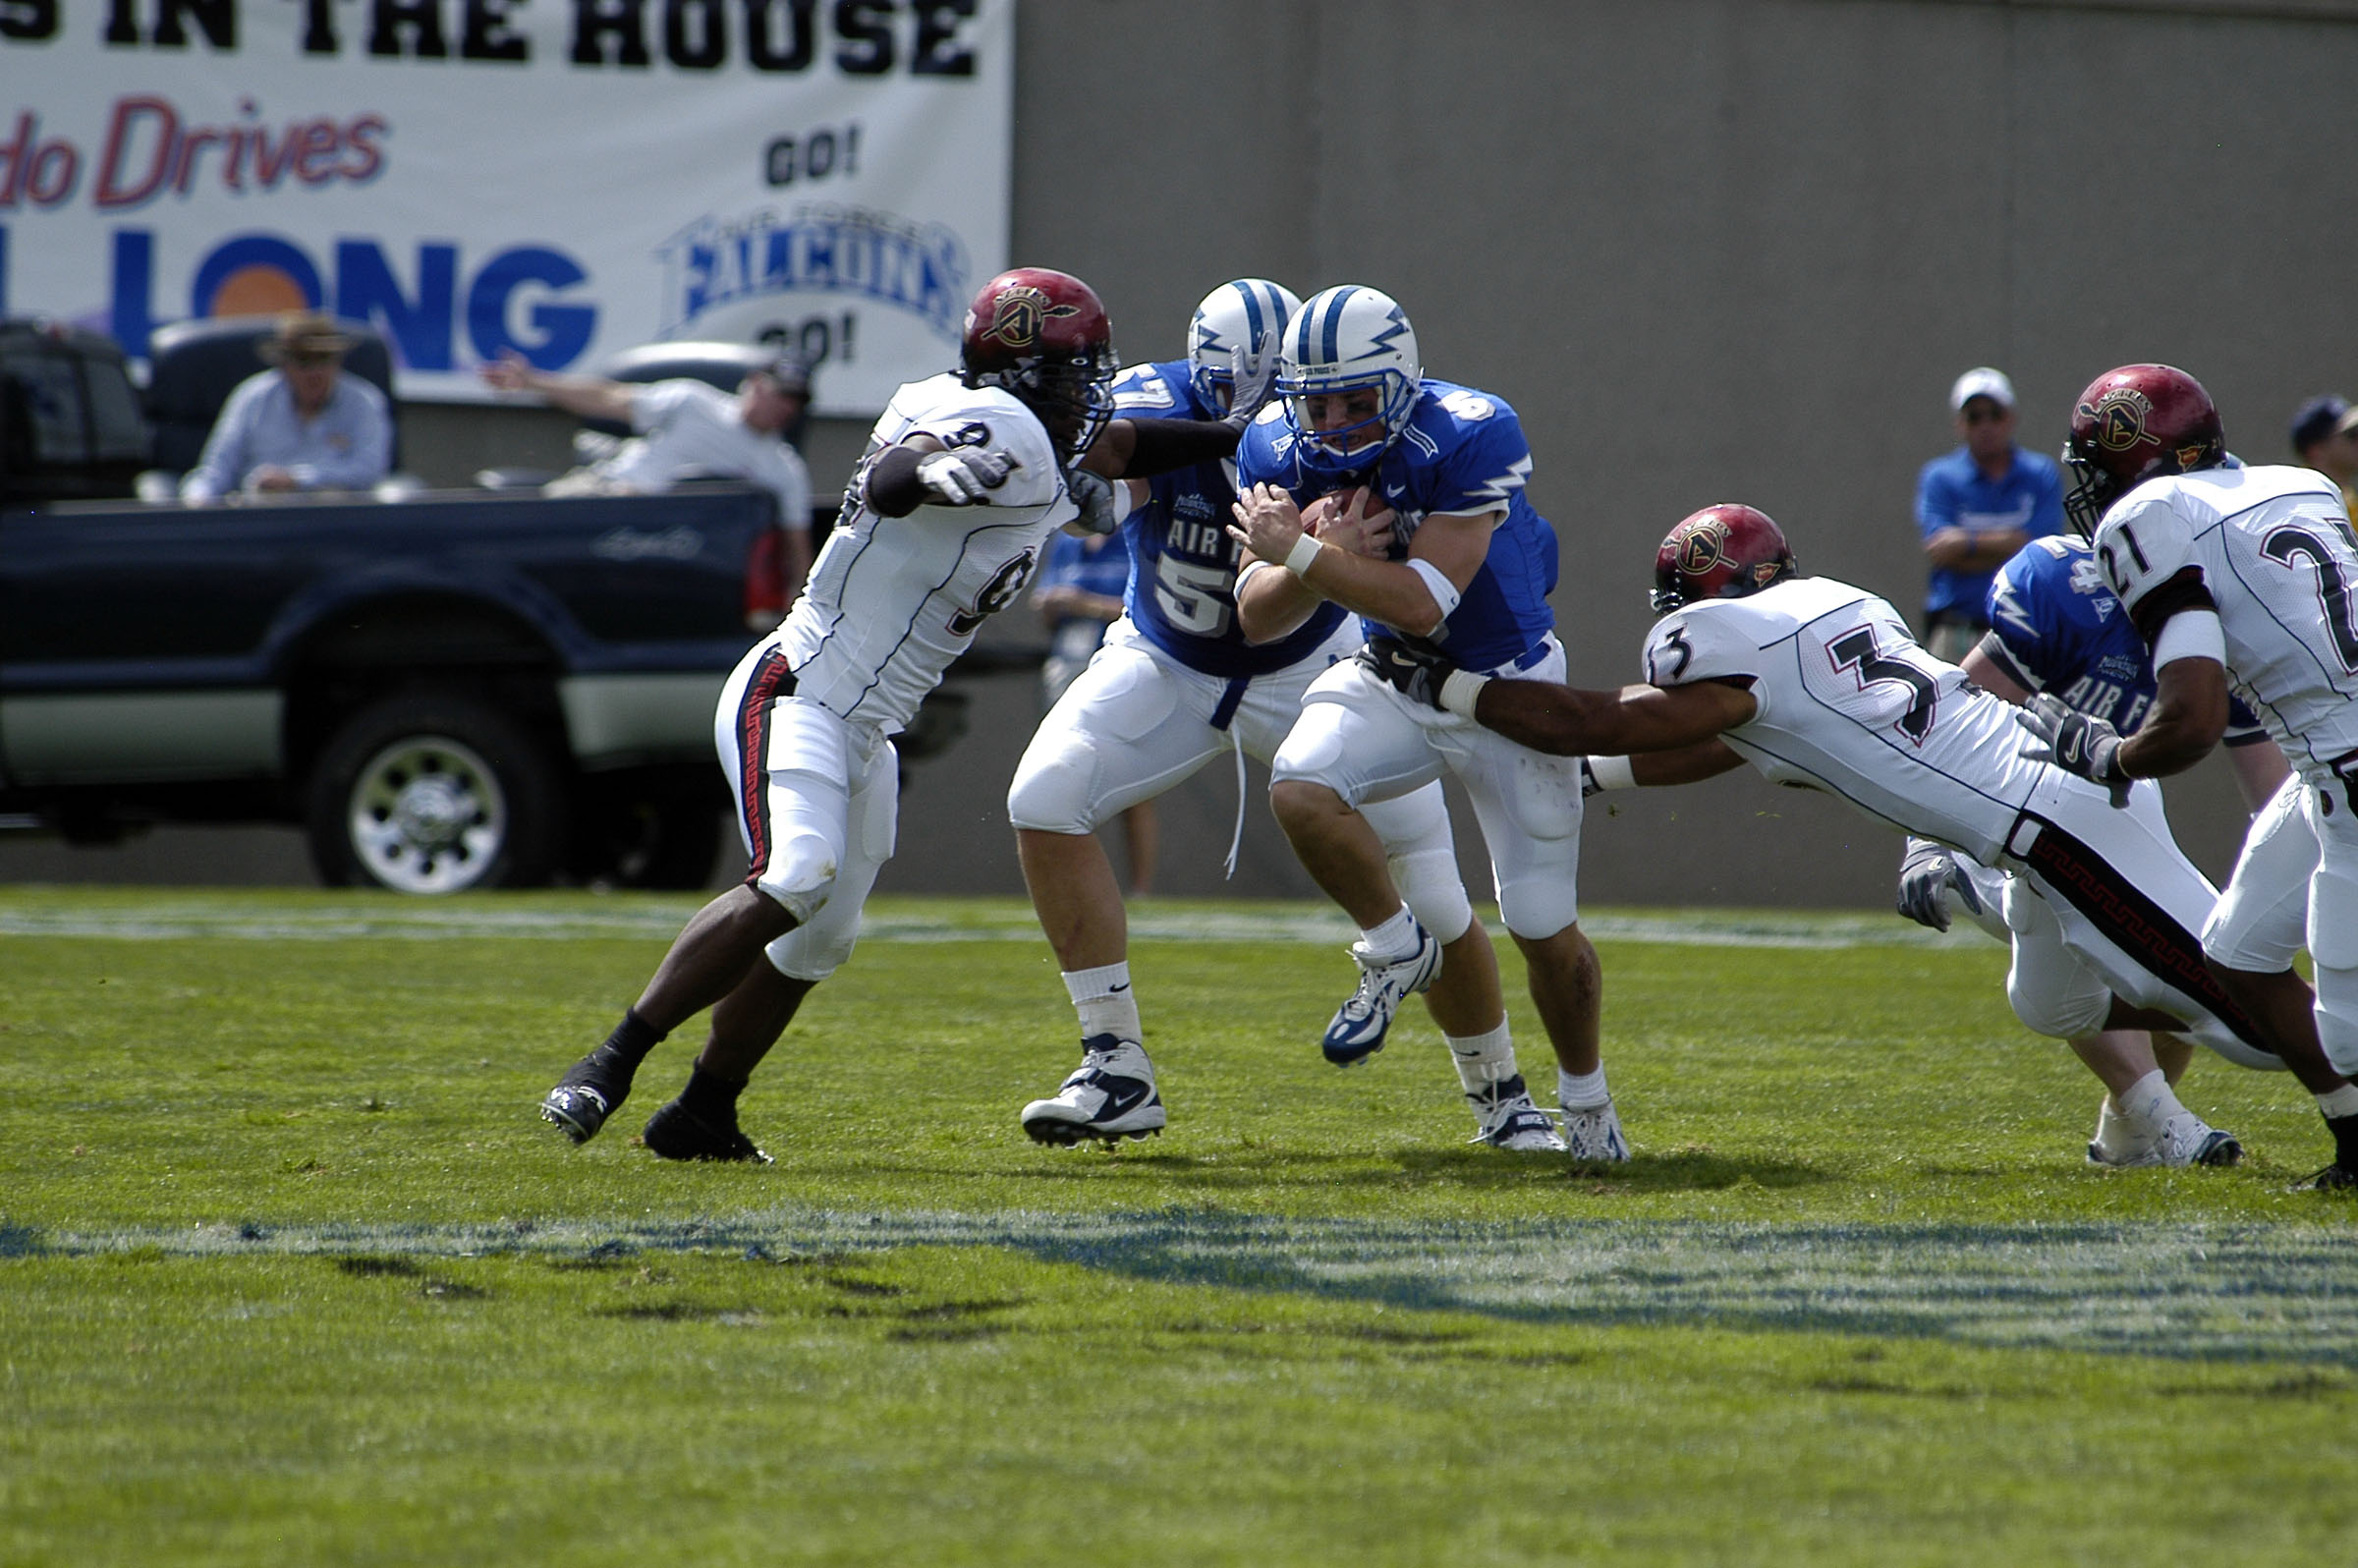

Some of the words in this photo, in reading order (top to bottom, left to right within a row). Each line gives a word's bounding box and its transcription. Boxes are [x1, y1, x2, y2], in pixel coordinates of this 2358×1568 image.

[103, 0, 239, 50] IN
[303, 0, 532, 62] THE
[569, 0, 976, 76] HOUSE
[95, 95, 387, 211] Drives
[764, 123, 863, 189] GO!
[112, 230, 598, 372] LONG
[652, 218, 971, 342] FALCONS
[1167, 519, 1219, 556] AIR
[2099, 520, 2155, 599] 21
[1153, 549, 1237, 639] 5
[2259, 519, 2358, 677] 2
[1824, 621, 1943, 749] 3
[2062, 675, 2123, 719] AIR
[1516, 1114, 1545, 1127] NIKE
